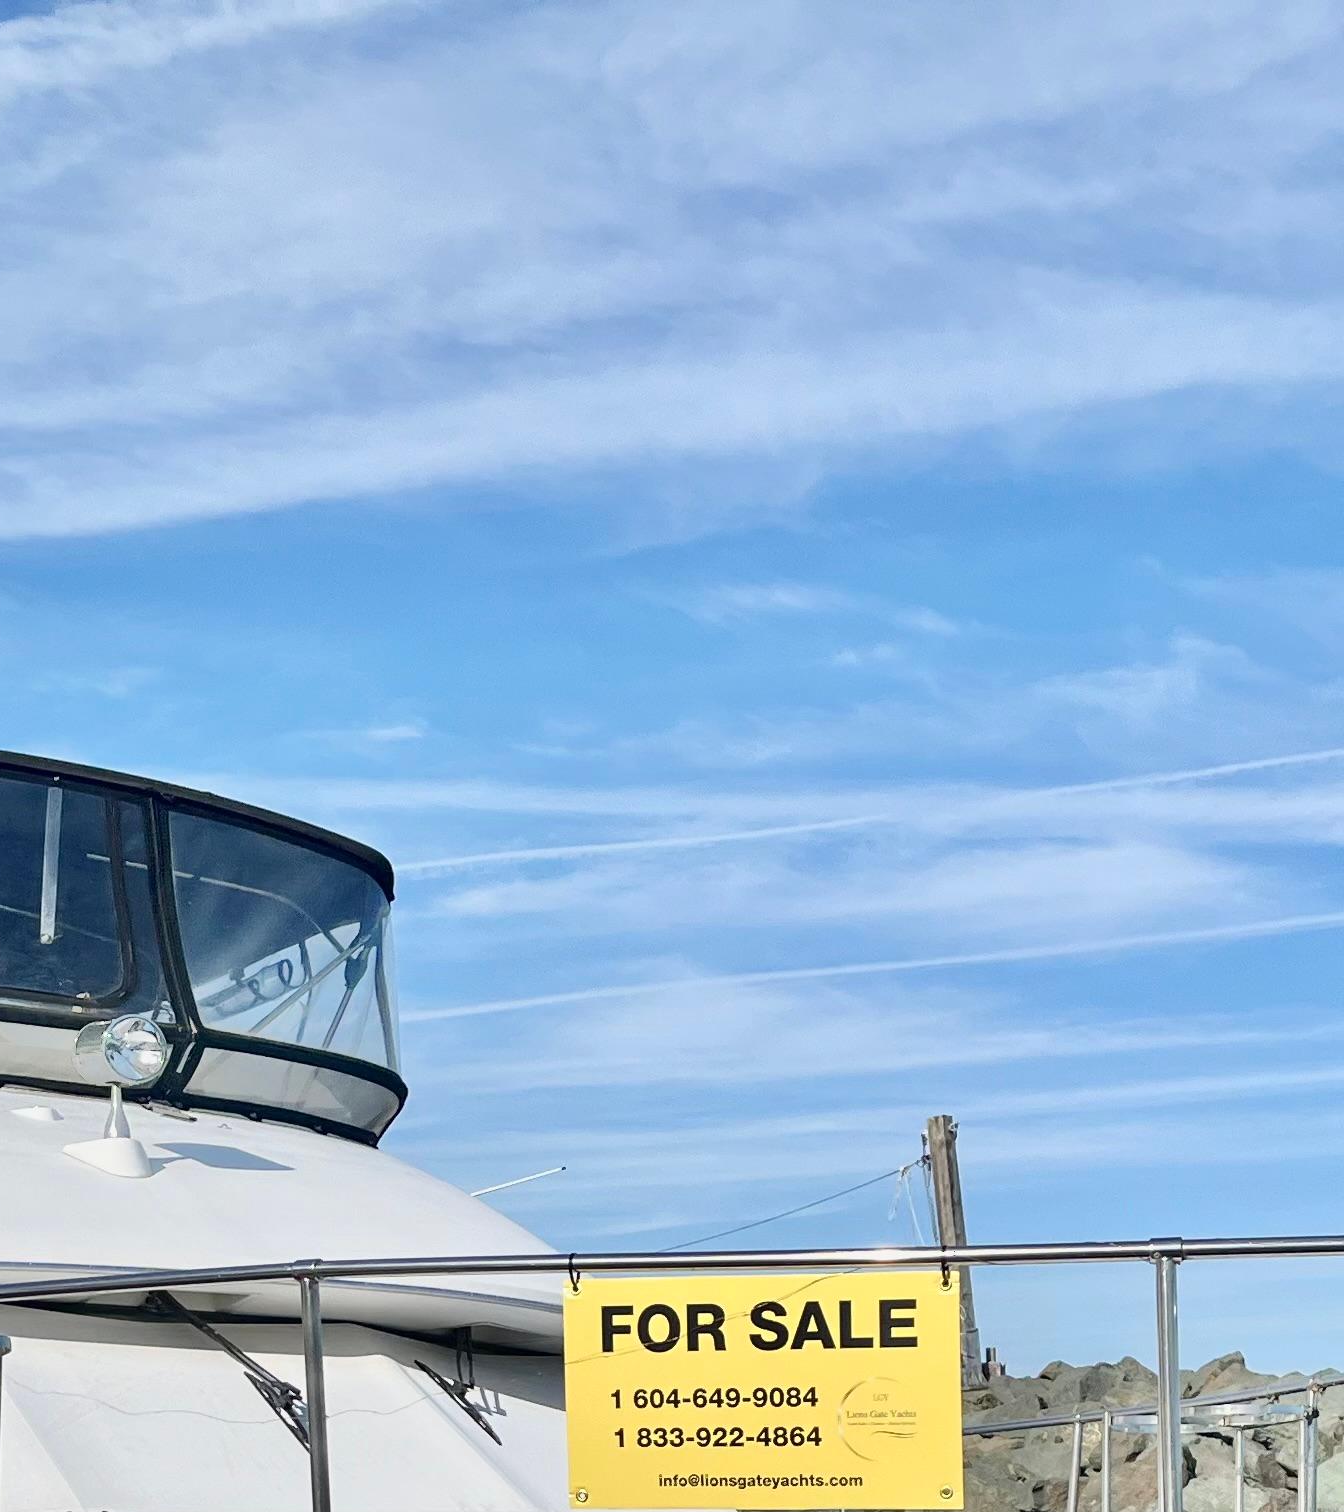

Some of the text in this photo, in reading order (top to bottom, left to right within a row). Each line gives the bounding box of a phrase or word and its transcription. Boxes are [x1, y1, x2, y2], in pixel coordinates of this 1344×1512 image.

[601, 1299, 919, 1353] FOR SALE
[611, 1386, 819, 1409] 1 604-649-9084
[614, 1426, 823, 1448] 1 833-922-4864
[658, 1473, 864, 1490] info@lionsgateyachts.com
